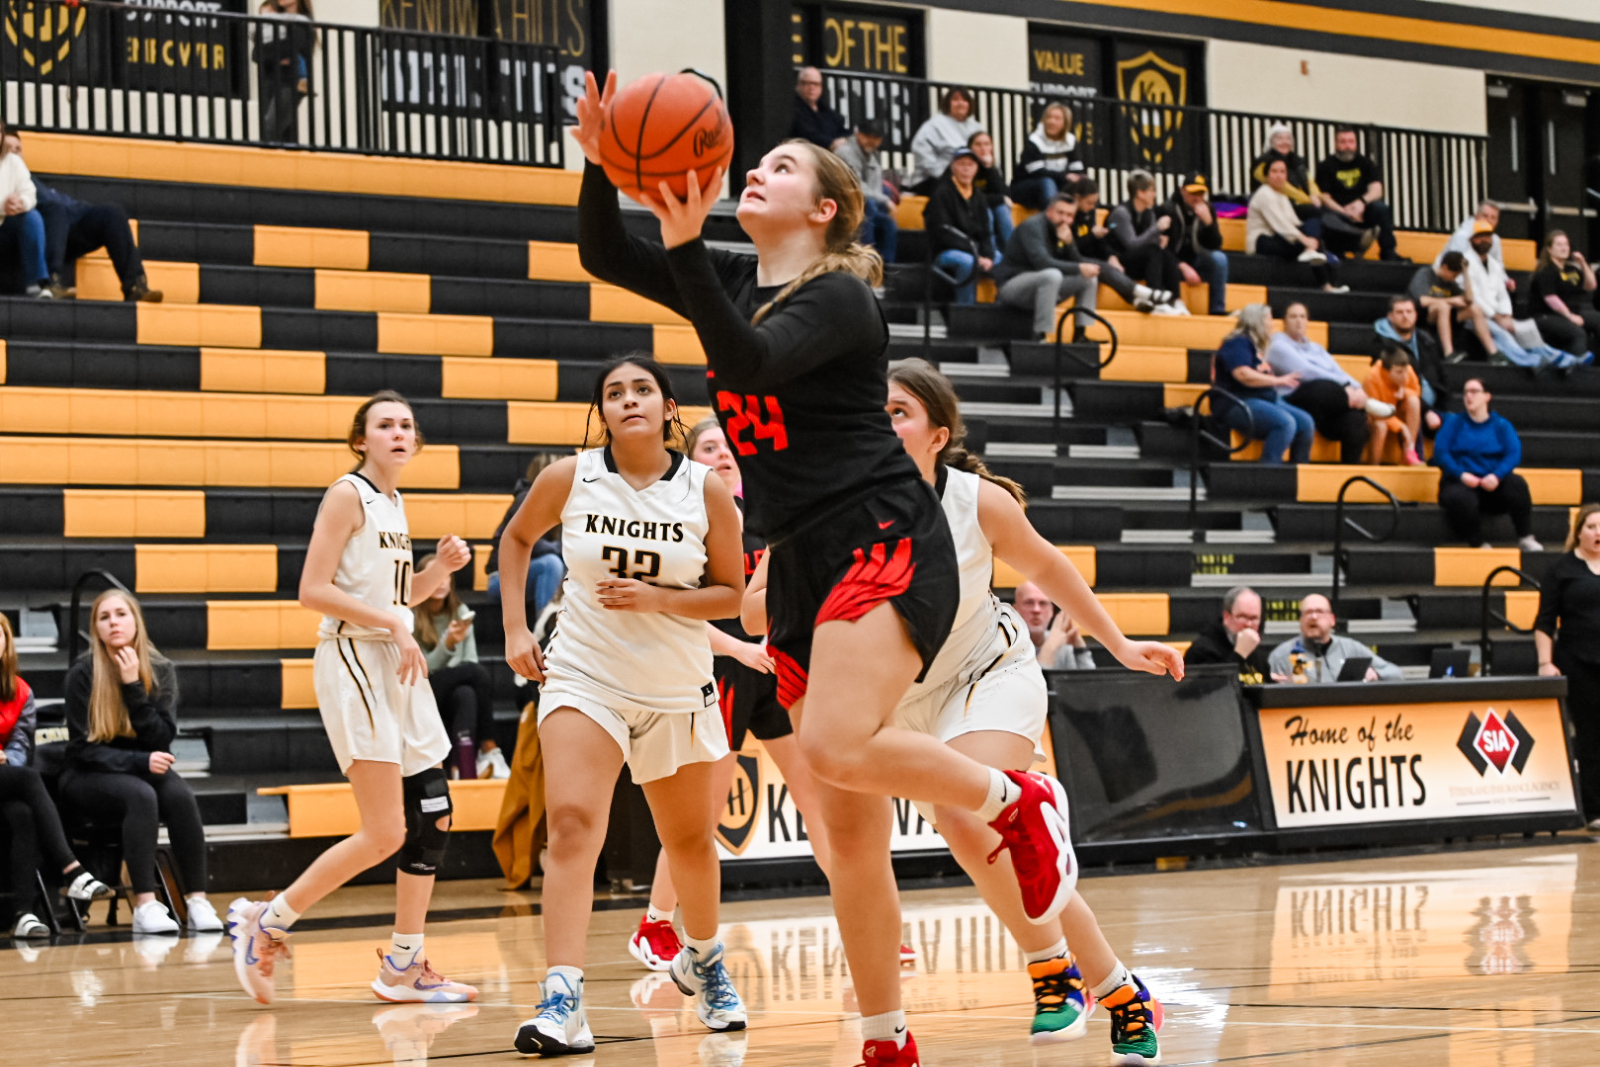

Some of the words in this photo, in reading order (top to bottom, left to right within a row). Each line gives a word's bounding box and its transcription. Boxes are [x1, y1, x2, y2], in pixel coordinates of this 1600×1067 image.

[825, 18, 856, 67] OF
[858, 22, 908, 73] THE
[1034, 50, 1085, 76] VALUE
[717, 390, 788, 457] 24
[585, 514, 684, 543] KNIGHTS
[602, 545, 662, 588] 32
[1285, 715, 1349, 747] Home
[1358, 716, 1376, 752] of
[1385, 713, 1414, 742] the
[1482, 730, 1511, 752] SIA
[1286, 754, 1426, 814] KNIGHTS
